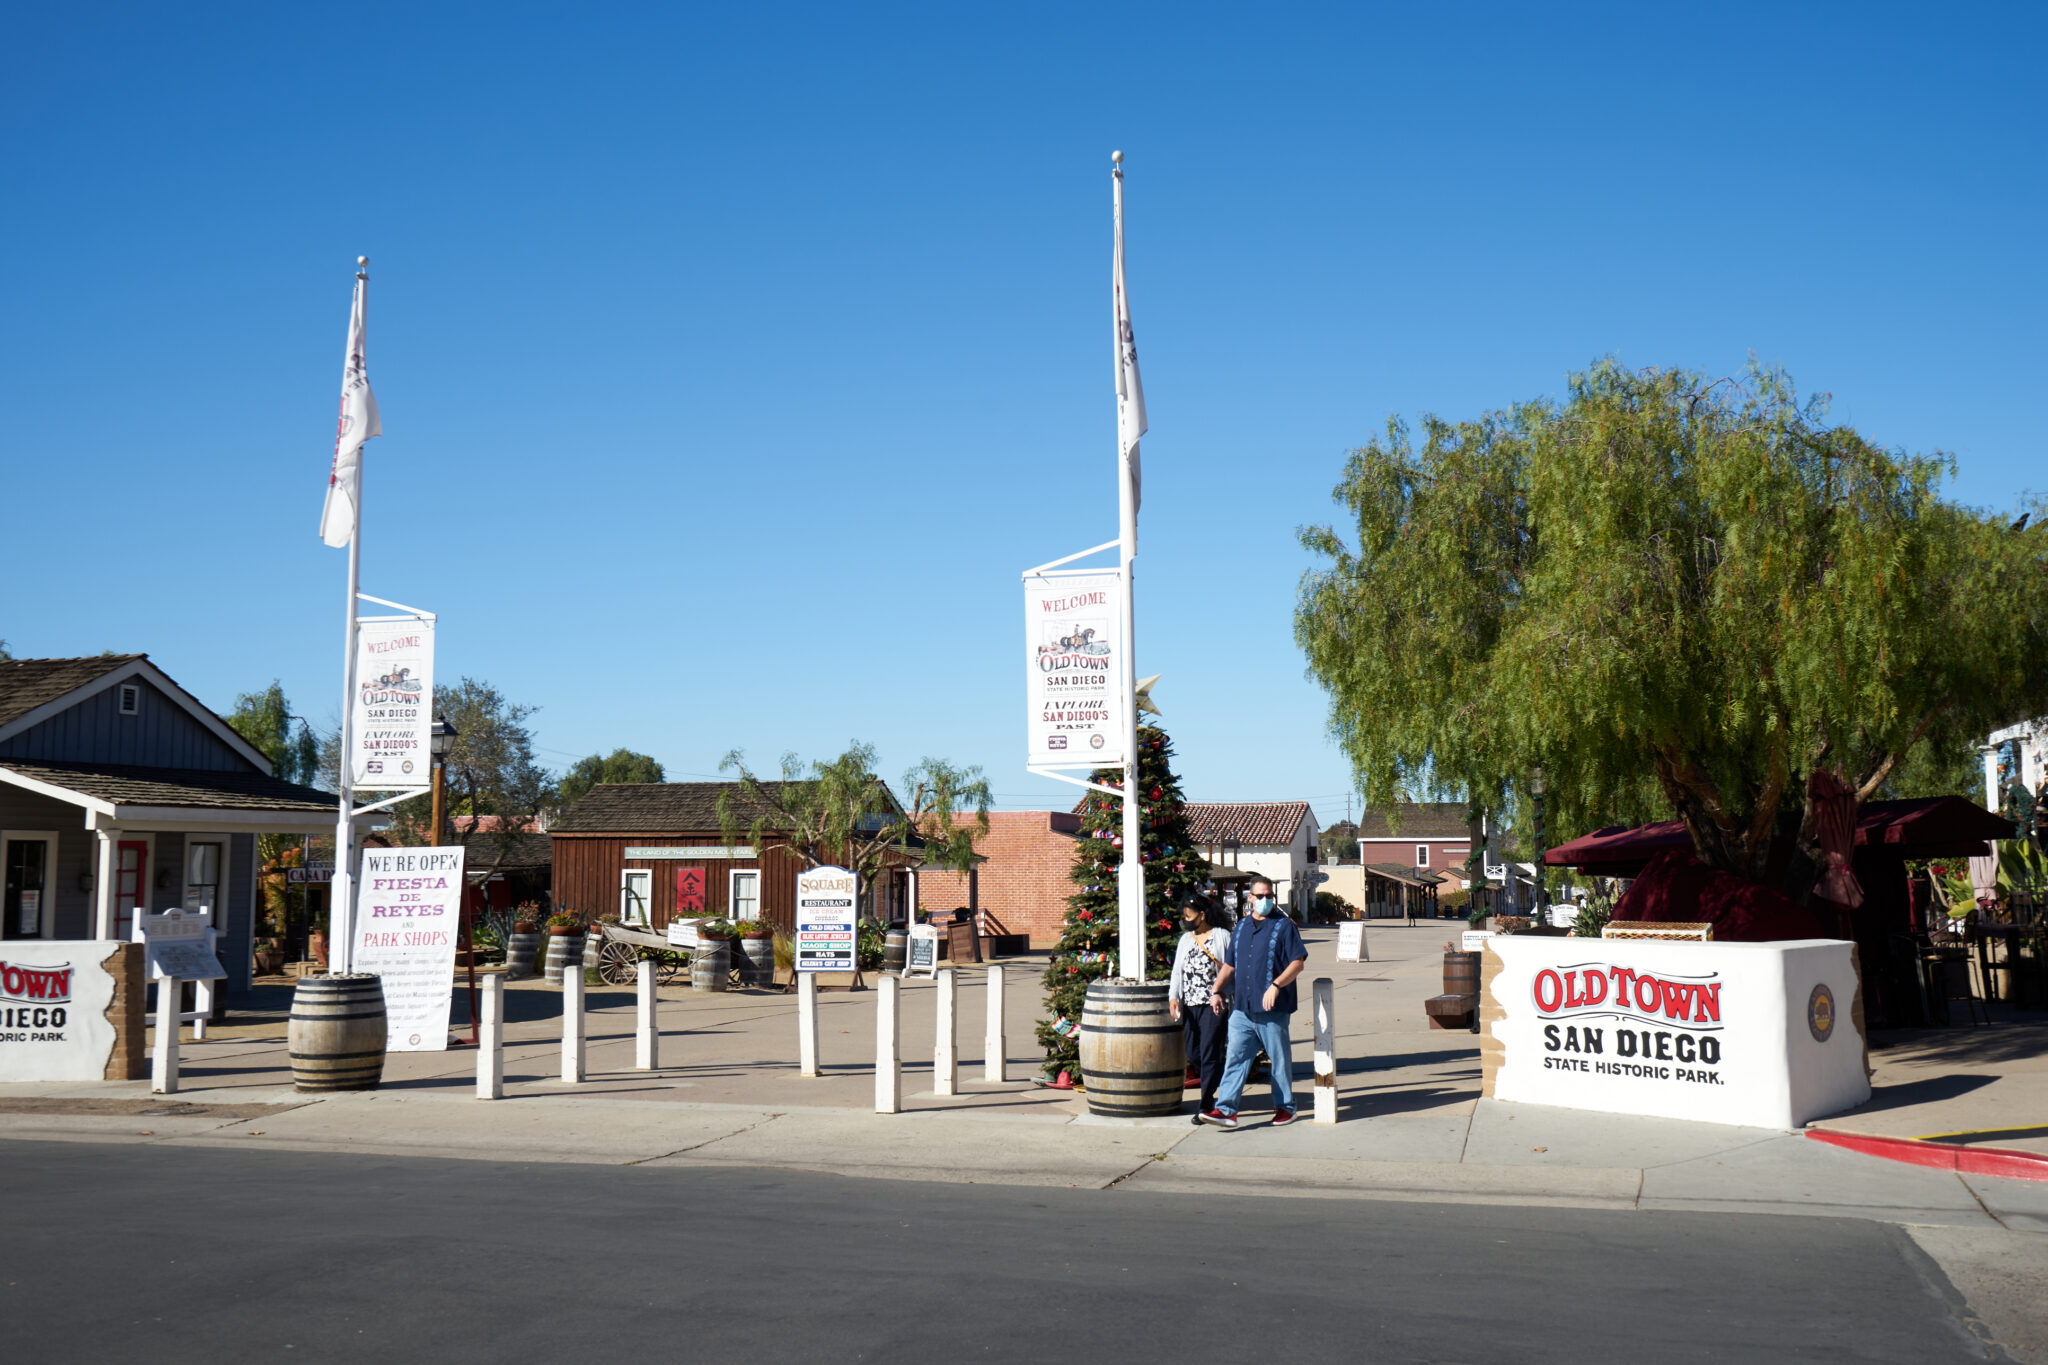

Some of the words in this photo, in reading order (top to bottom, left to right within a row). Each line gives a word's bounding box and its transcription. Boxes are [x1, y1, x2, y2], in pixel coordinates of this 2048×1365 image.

[1041, 592, 1107, 613] WELCOME
[367, 635, 421, 654] WELCOME
[1040, 654, 1071, 673] OLD
[1071, 654, 1110, 670] TOWN
[1047, 676, 1068, 686] SAN
[1072, 675, 1106, 685] DIEGO
[362, 690, 389, 706] OLD
[390, 690, 421, 705] TOWN
[1044, 700, 1107, 710] EXPLORE
[368, 709, 385, 718] SAN
[388, 709, 417, 717] DIEGO
[1042, 711, 1064, 722] SAN
[1067, 710, 1109, 721] DIEGO'S
[364, 731, 416, 739] EXPLORE
[363, 740, 380, 749] SAN
[383, 740, 418, 749] DIEGO'S
[368, 856, 415, 872] WE'RE
[420, 854, 459, 871] OPEN
[372, 877, 448, 890] FIESTA
[800, 878, 854, 894] SQUARE
[399, 893, 422, 902] DE
[371, 904, 445, 918] REYES
[363, 932, 400, 947] PARK
[403, 931, 448, 946] SHOPS
[1533, 968, 1608, 1013] OLD
[1609, 965, 1722, 1023] TOWN
[0, 1007, 67, 1028] IEGO
[1544, 1024, 1604, 1055] SAN
[1616, 1028, 1722, 1065] DIEGO
[1543, 1057, 1590, 1073] STATE
[1596, 1061, 1670, 1080] HISTORIC
[1675, 1068, 1725, 1086] PARK.
